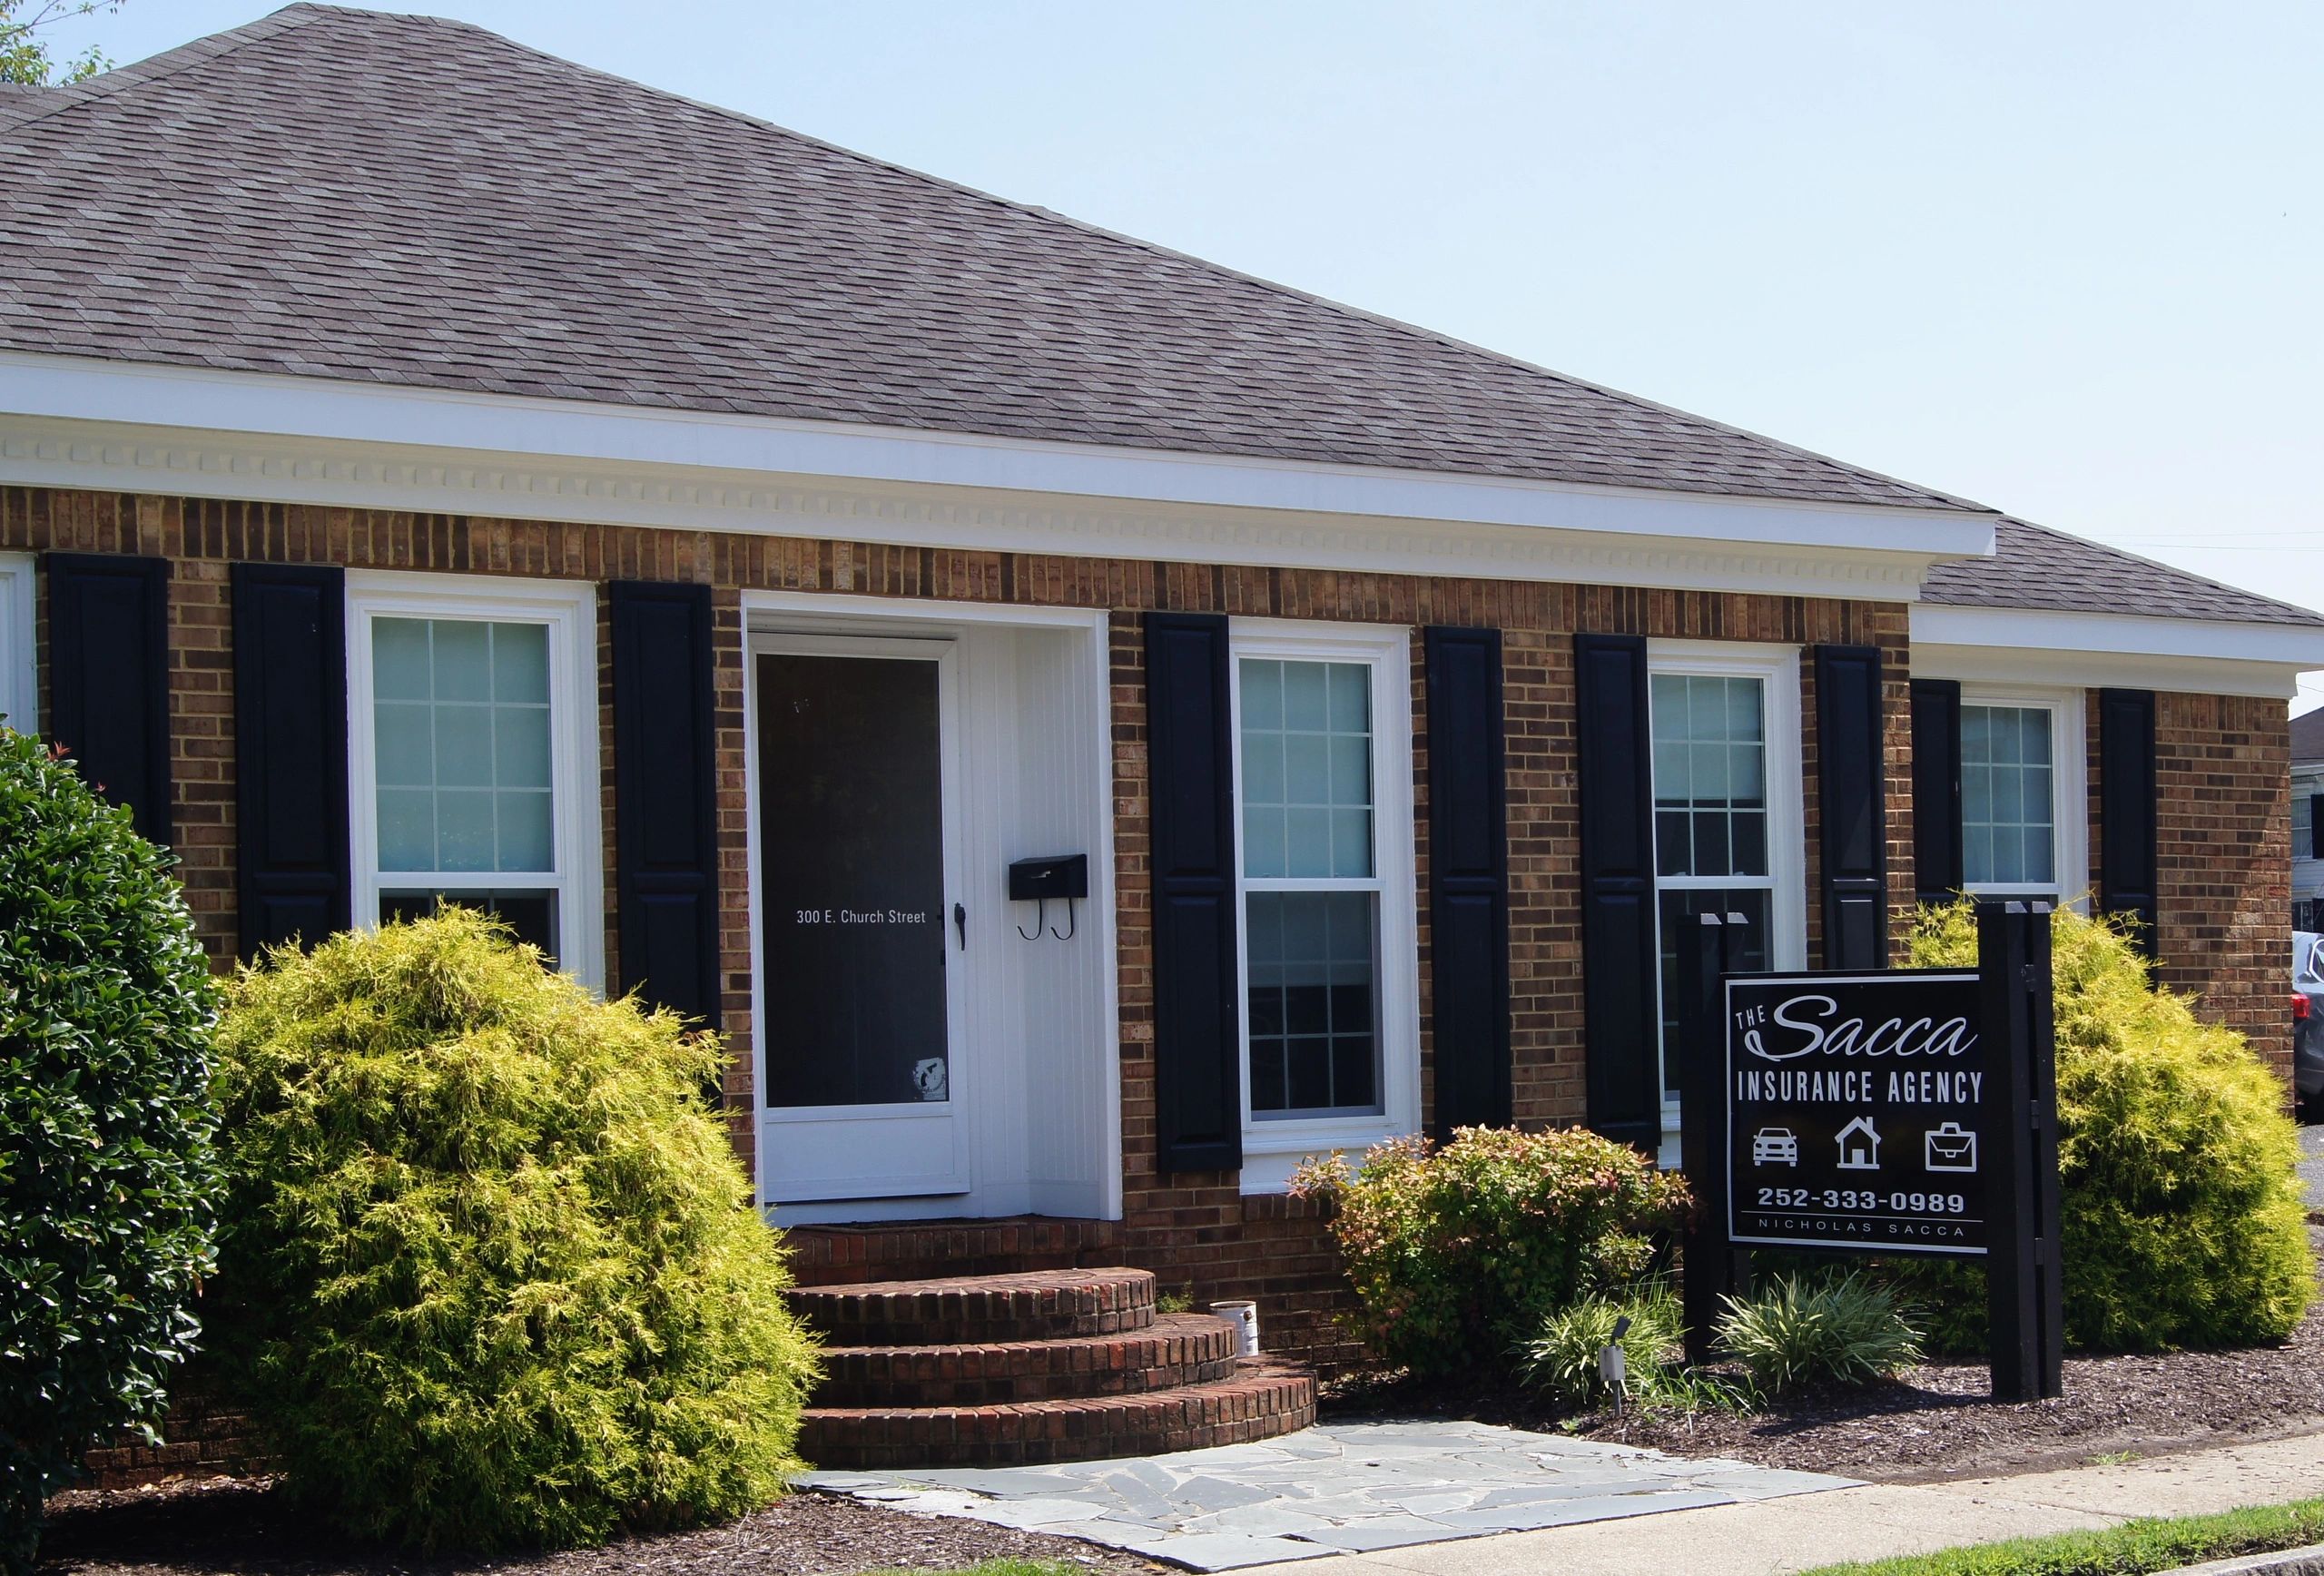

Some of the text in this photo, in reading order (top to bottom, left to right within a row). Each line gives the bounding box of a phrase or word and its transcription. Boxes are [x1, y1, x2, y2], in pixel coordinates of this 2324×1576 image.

[796, 909, 926, 923] 300 E. Church Street
[1735, 994, 1978, 1061] THE Sacca
[1738, 1070, 1983, 1104] INSURANCE AGENCY
[1758, 1187, 1965, 1213] 252-333-0989
[1758, 1218, 1964, 1236] NICHOLAS SACCA
